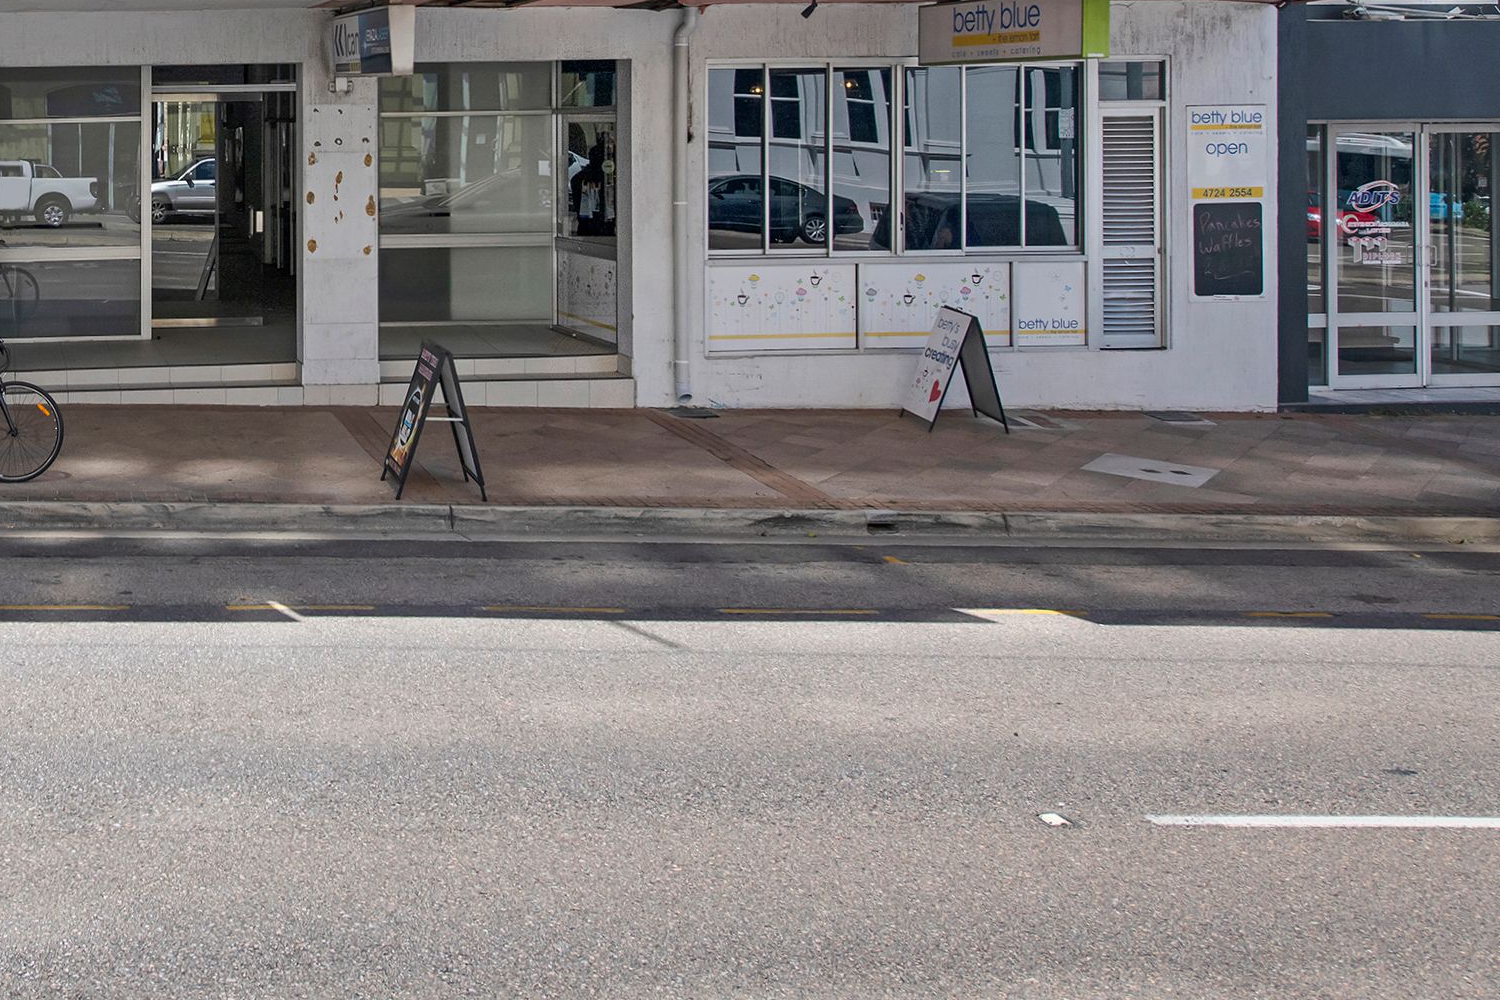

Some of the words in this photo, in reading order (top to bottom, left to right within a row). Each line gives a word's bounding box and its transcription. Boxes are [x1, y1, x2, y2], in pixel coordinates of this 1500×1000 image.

[953, 3, 995, 36] betty
[1000, 1, 1041, 29] blue
[1191, 110, 1227, 125] betty
[1231, 110, 1262, 123] blue
[1206, 143, 1248, 157] open
[1203, 188, 1226, 198] 4724
[1229, 187, 1252, 197] 2554
[1347, 190, 1401, 205] ADITS
[1199, 211, 1261, 235] Pancakes
[1018, 319, 1049, 331] betty
[1052, 318, 1079, 330] blue
[924, 347, 955, 370] creating
